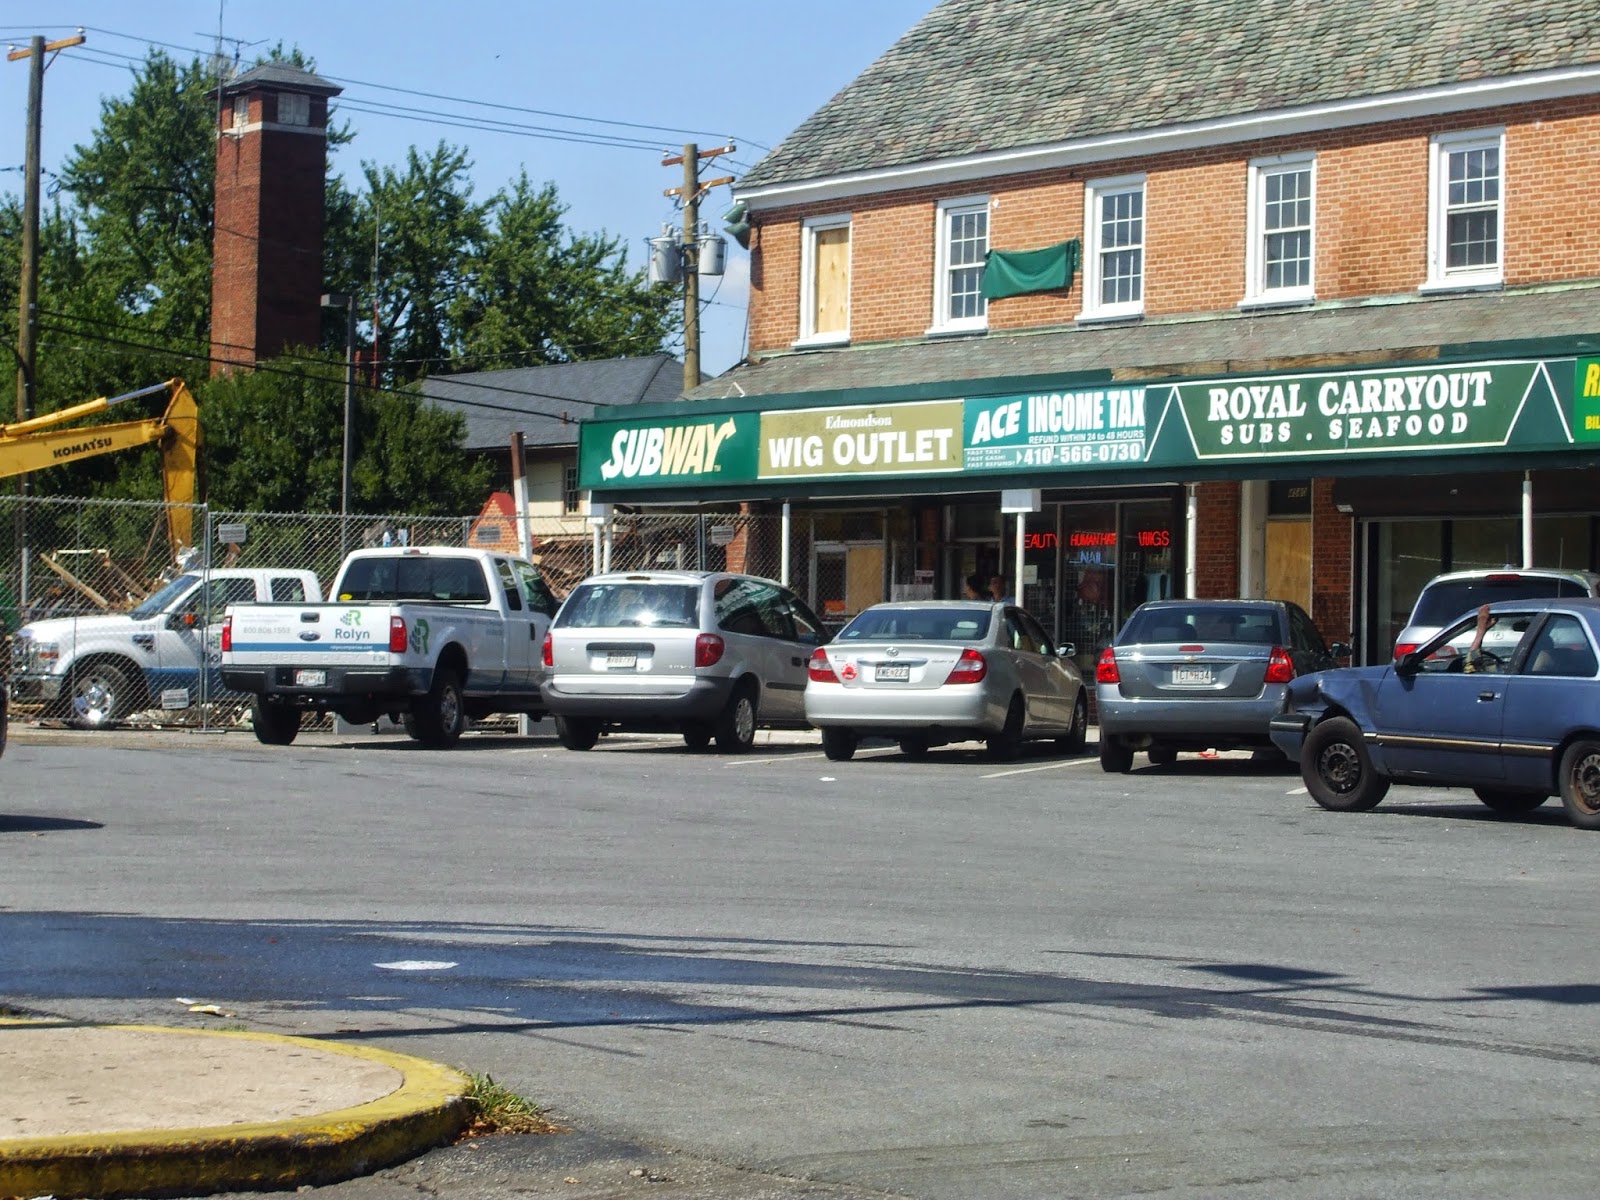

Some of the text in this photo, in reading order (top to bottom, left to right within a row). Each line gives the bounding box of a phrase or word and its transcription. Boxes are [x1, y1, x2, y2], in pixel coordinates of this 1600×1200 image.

[1583, 363, 1600, 397] R
[1207, 371, 1492, 422] ROYAL CARRYOUT
[825, 413, 893, 430] Edmondson
[971, 389, 1146, 446] ACE INCOME TAX
[1220, 422, 1291, 446] SUBS
[1329, 411, 1469, 440] SEAFOOD
[53, 437, 112, 458] KOMATSU
[768, 428, 954, 468] WIG OUTLET
[1028, 434, 1059, 445] REFUND
[1060, 432, 1086, 443] WITHIN
[1086, 432, 1097, 442] 24
[1117, 429, 1145, 440] HOURS
[601, 417, 737, 481] SUBWAY
[1023, 442, 1141, 465] 410-566-0730
[1018, 533, 1059, 549] EAUTY
[1138, 530, 1170, 547] WIGS
[335, 628, 370, 641] Rolyn
